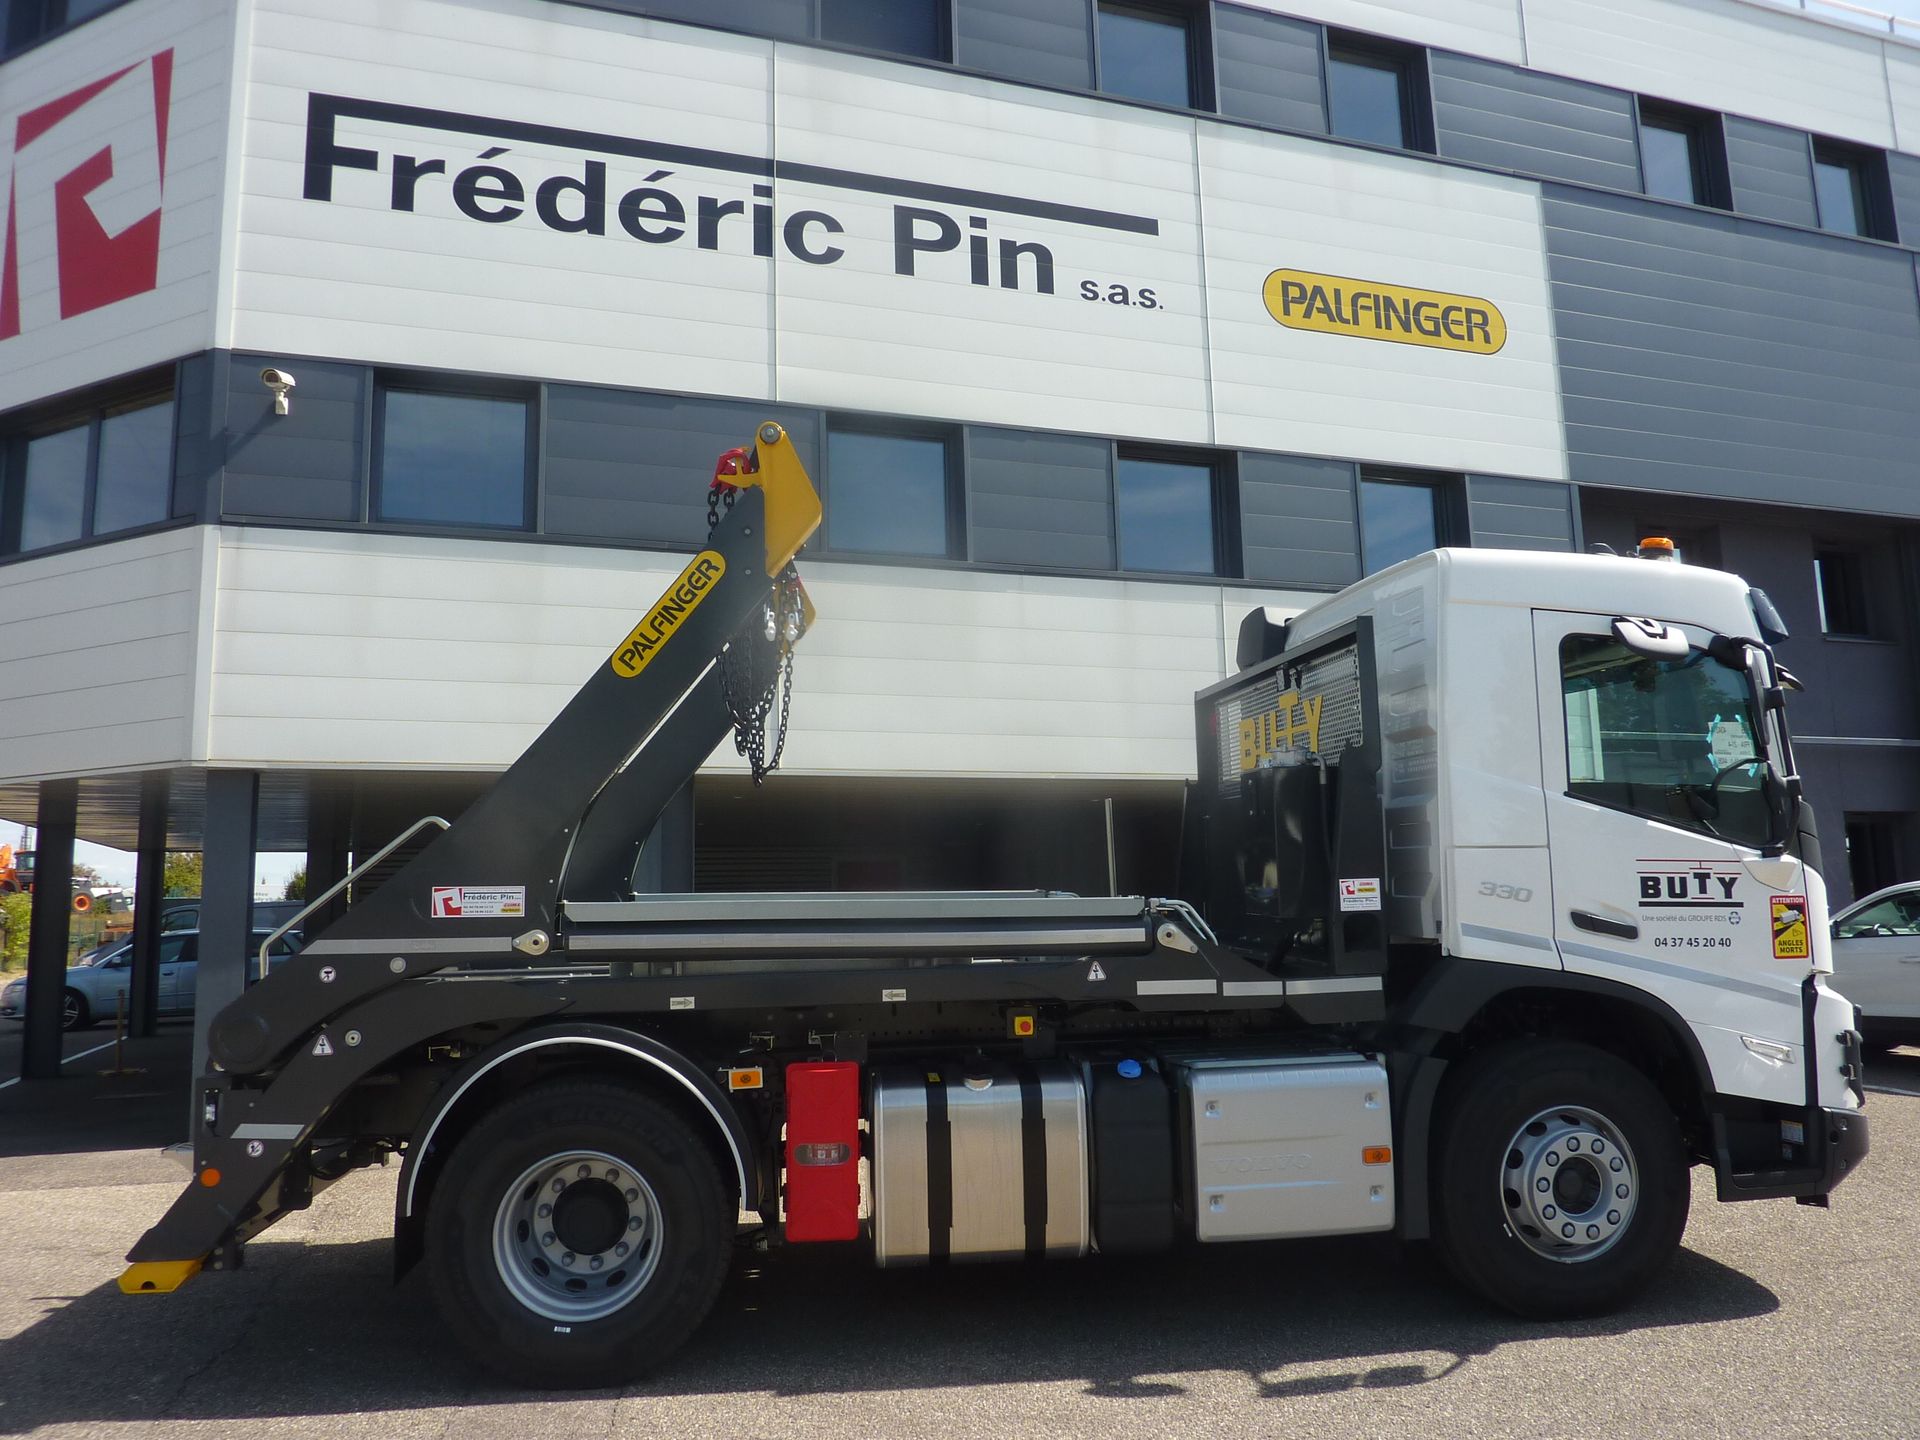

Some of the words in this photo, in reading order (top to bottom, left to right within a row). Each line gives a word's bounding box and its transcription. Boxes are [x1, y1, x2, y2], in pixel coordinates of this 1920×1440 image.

[303, 92, 845, 265] Frédéric
[893, 203, 1055, 294] Pin
[1079, 279, 1164, 310] s.a.s.
[1281, 280, 1491, 344] PALFINGER
[618, 558, 720, 671] PALFINGER
[1478, 881, 1533, 902] 330
[1640, 872, 1738, 899] BUTY
[463, 892, 497, 901] Frédéric
[1678, 914, 1687, 922] du
[1687, 914, 1714, 922] GROUPE
[1654, 937, 1668, 947] 04
[1670, 937, 1684, 947] 37
[1686, 937, 1700, 947] 45
[1702, 937, 1716, 947] 20
[1718, 937, 1731, 947] 40
[1778, 939, 1804, 947] ANGLES
